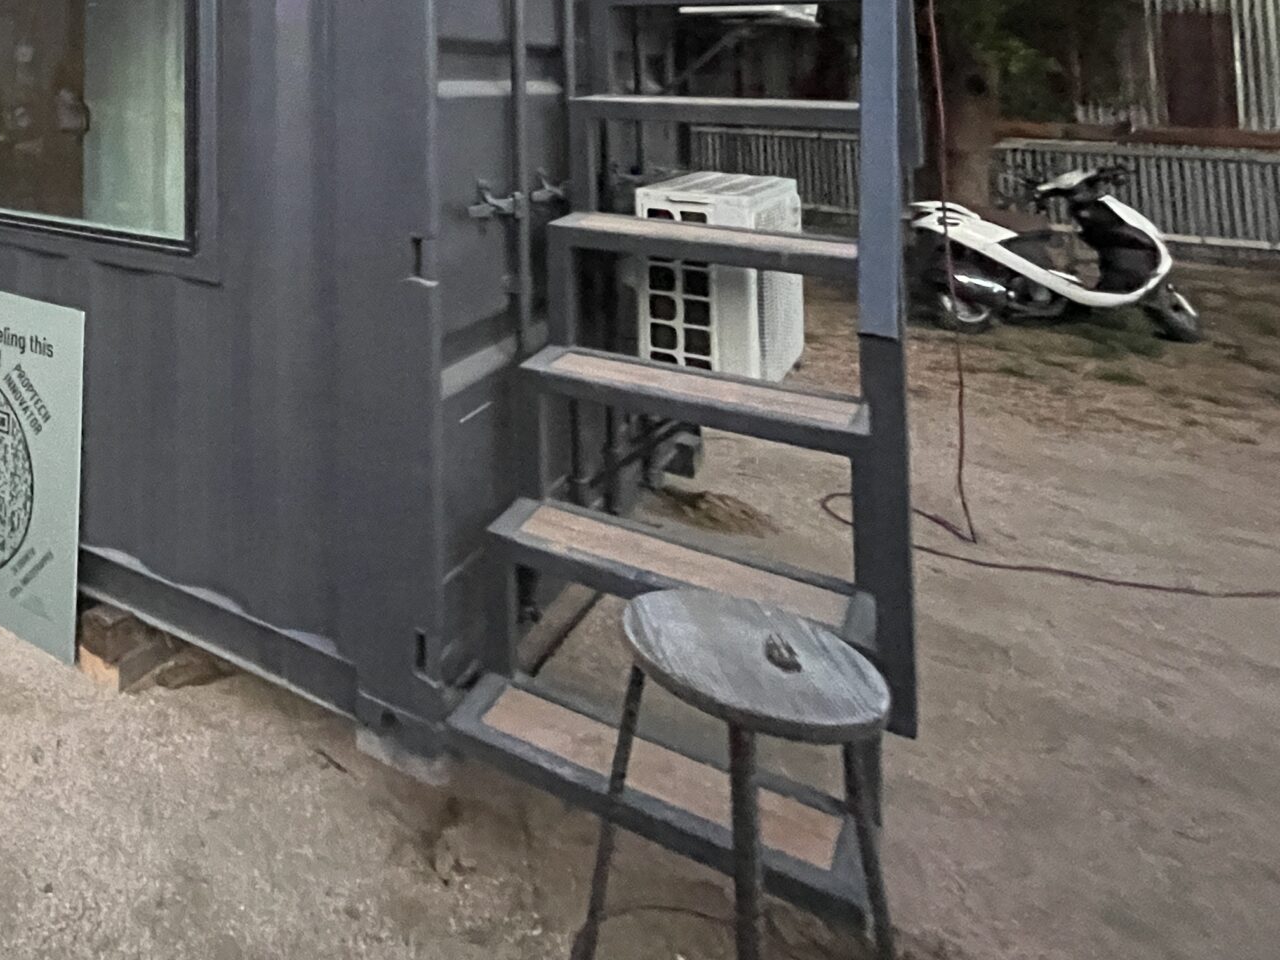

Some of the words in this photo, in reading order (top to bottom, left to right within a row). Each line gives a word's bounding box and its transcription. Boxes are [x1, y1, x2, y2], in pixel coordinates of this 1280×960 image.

[29, 335, 54, 359] this
[3, 372, 43, 436] INNOVATOR
[13, 362, 52, 424] PROPTECH
